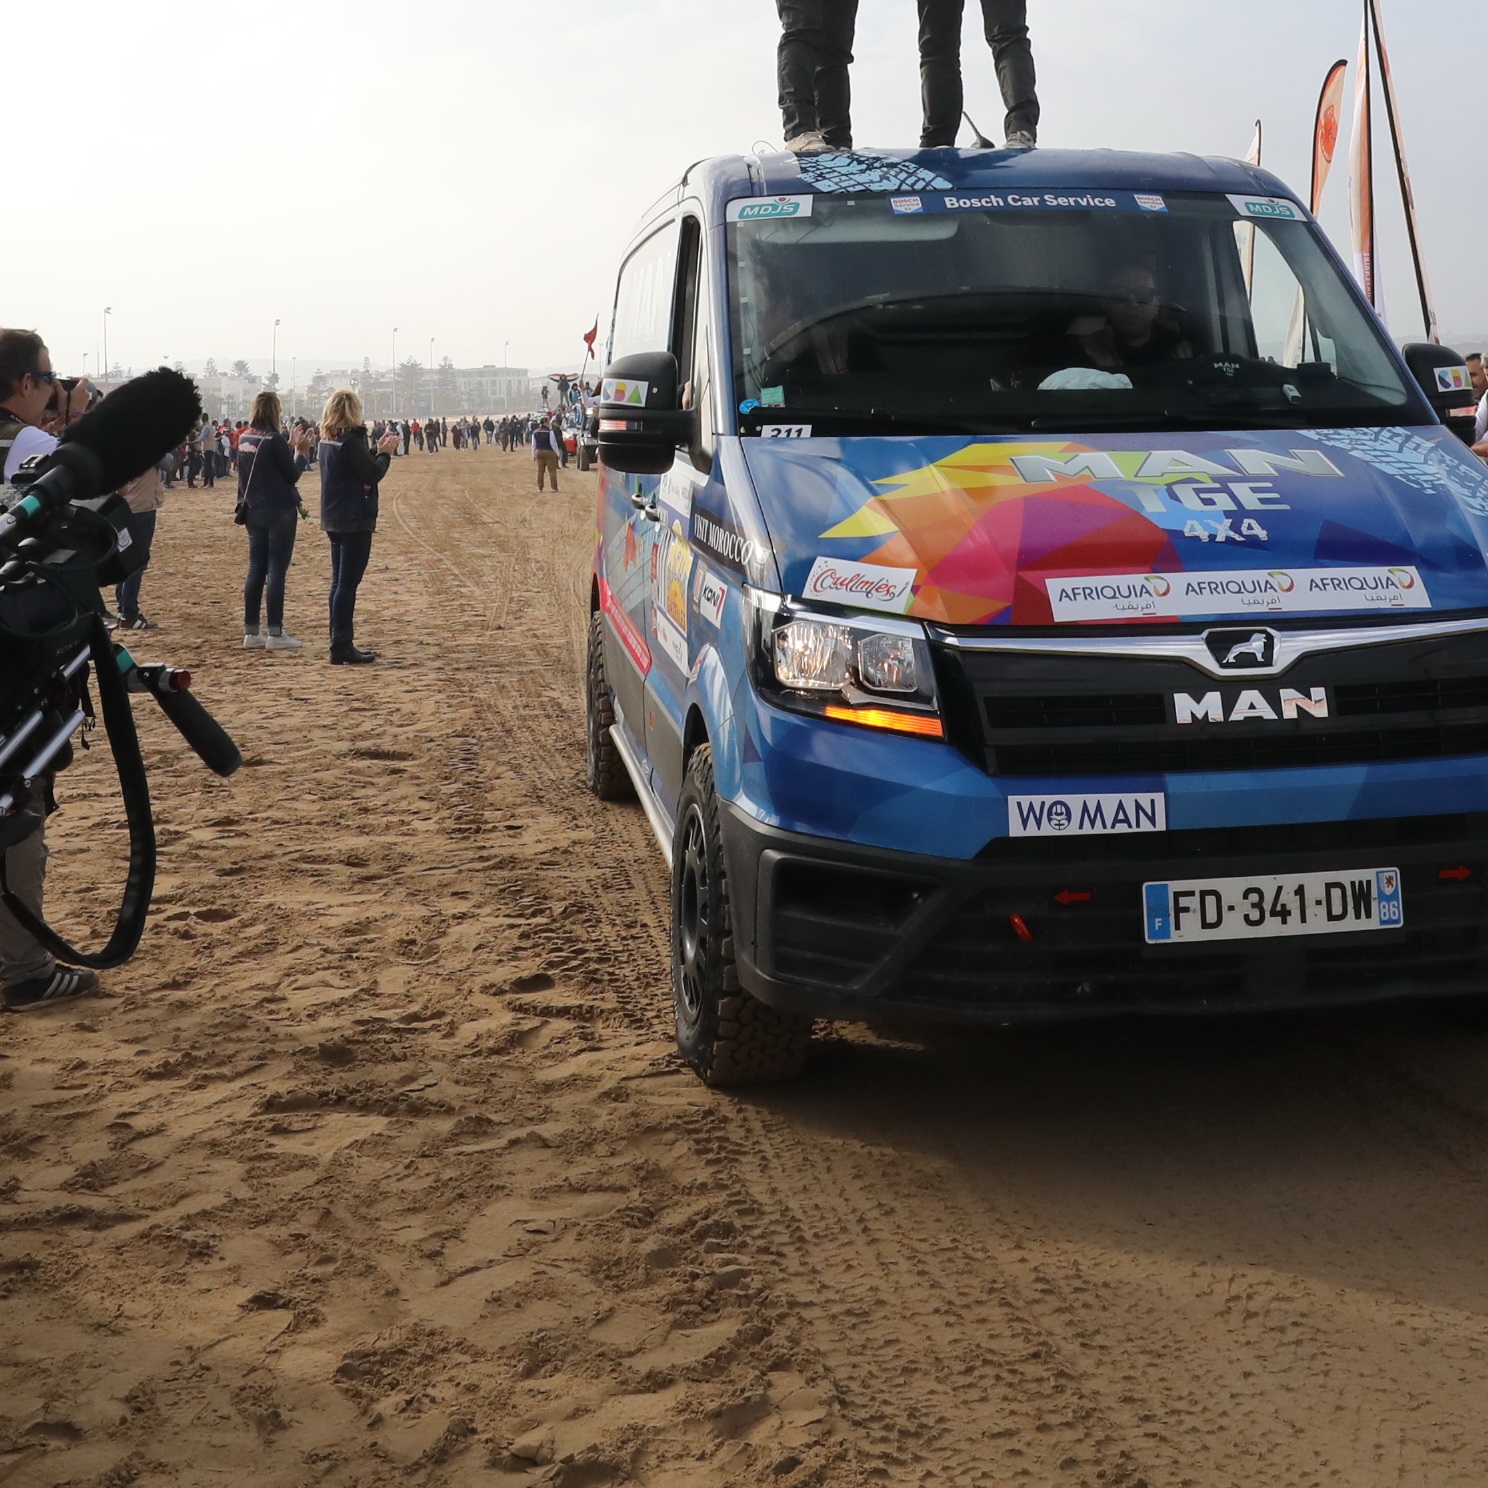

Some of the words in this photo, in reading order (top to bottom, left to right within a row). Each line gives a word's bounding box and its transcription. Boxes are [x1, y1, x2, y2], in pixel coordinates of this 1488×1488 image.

[743, 204, 795, 216] MDJS
[944, 195, 1003, 209] Bosch
[1007, 194, 1041, 207] Car
[1044, 194, 1116, 207] Service
[1248, 203, 1292, 217] MDJS
[1010, 450, 1345, 483] MAN
[1117, 482, 1291, 513] TGE
[694, 513, 709, 545] VISIT
[708, 523, 754, 565] MOROCCO
[1183, 518, 1269, 542] 4X4
[1058, 584, 1152, 602] AFRIQUIA
[1185, 580, 1279, 596] AFRIQUIA
[1309, 576, 1398, 592] AFRIQUIA
[1173, 686, 1329, 724] MAN
[1172, 879, 1373, 931] FD-341-DW
[1379, 900, 1399, 922] 86
[1154, 918, 1163, 930] F
